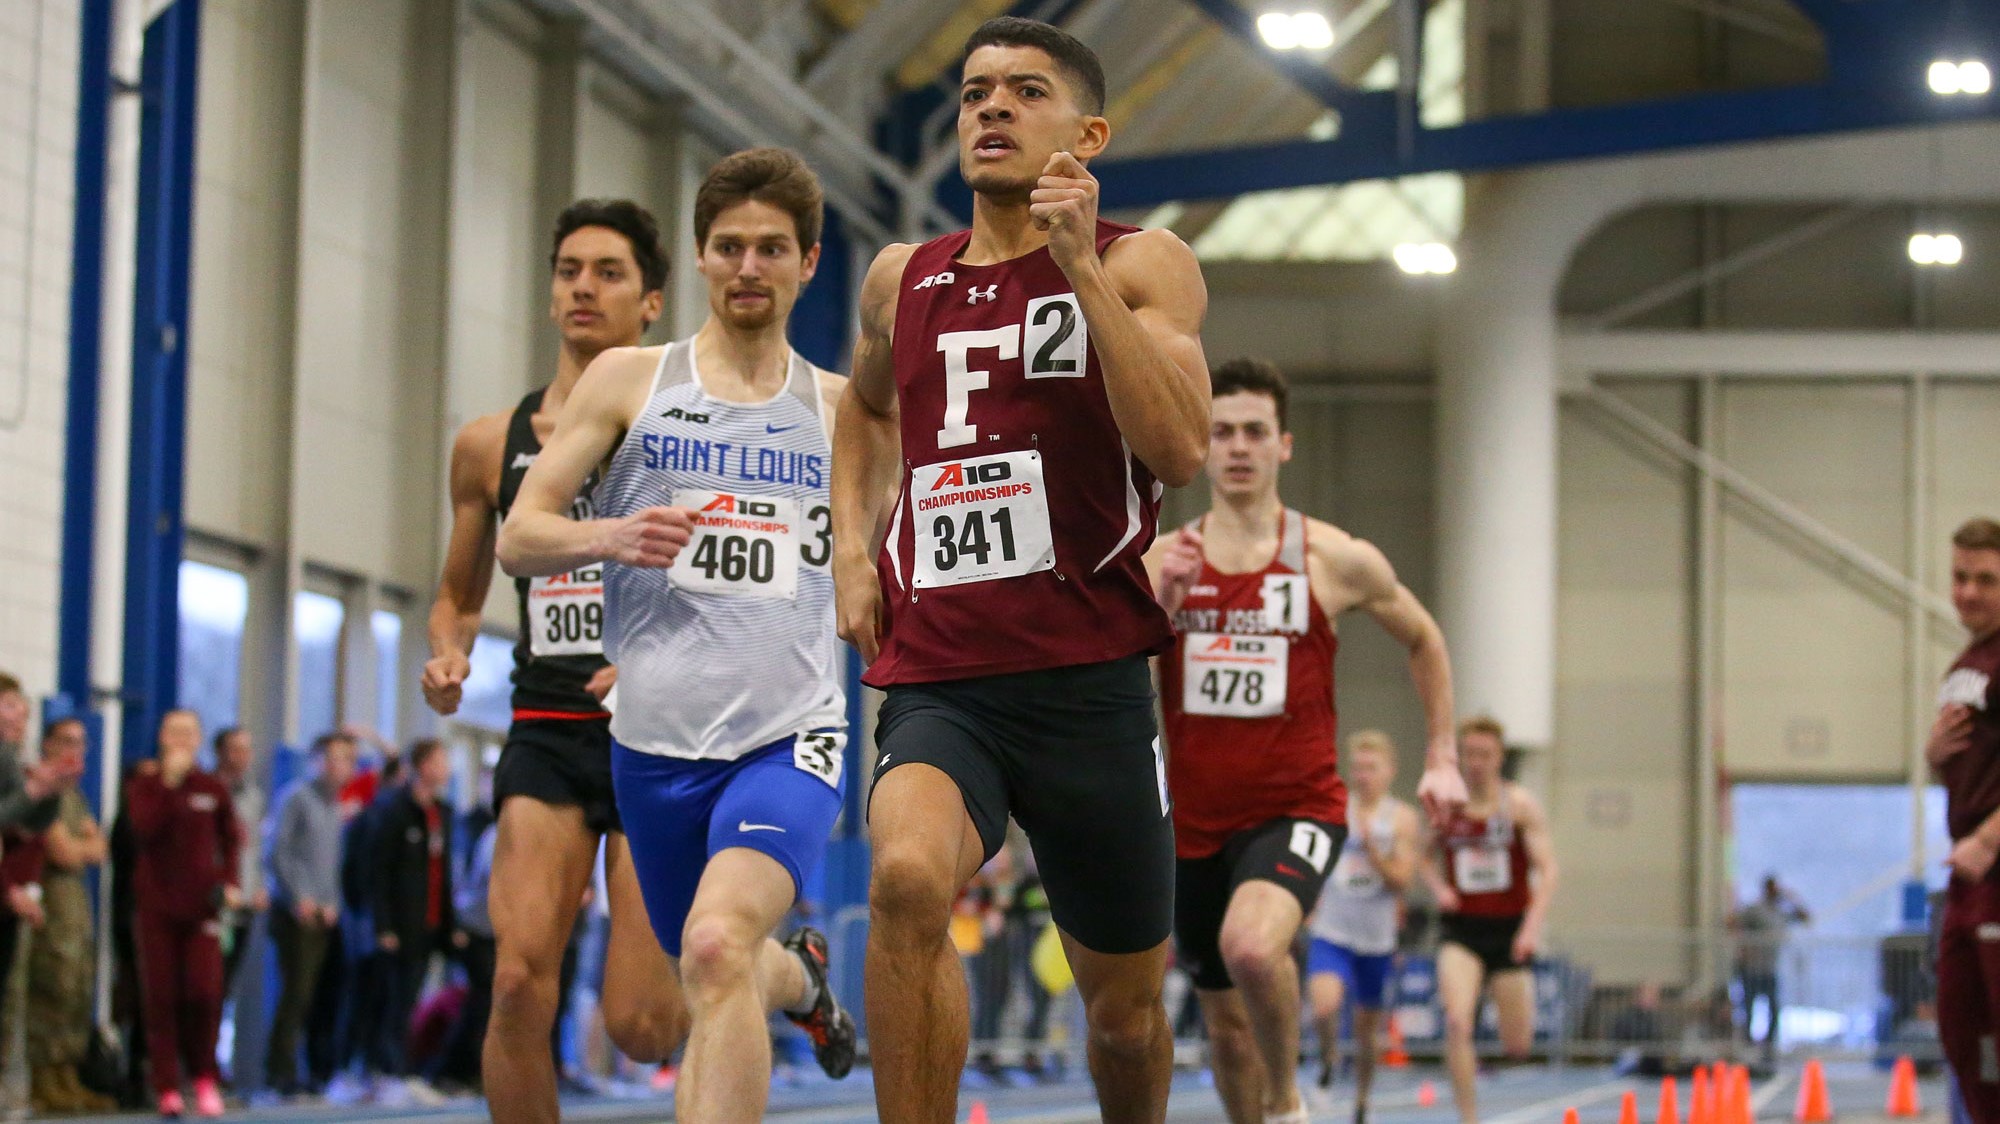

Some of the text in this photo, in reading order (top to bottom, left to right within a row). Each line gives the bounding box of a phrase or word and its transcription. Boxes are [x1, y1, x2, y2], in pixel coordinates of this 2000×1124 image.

[1032, 301, 1076, 373] 2
[936, 324, 1020, 449] F
[660, 407, 710, 424] A10
[642, 433, 822, 489] SAINT LOUIS
[930, 461, 1012, 492] A10
[700, 493, 776, 518] A10
[918, 482, 1032, 512] CHAMPIONSHIPS
[800, 505, 832, 567] 3
[933, 506, 1016, 572] 341
[691, 534, 774, 584] 460
[545, 602, 603, 643] 309
[1274, 580, 1292, 625] 1
[1200, 669, 1264, 705] 478
[1303, 830, 1317, 858] 1
